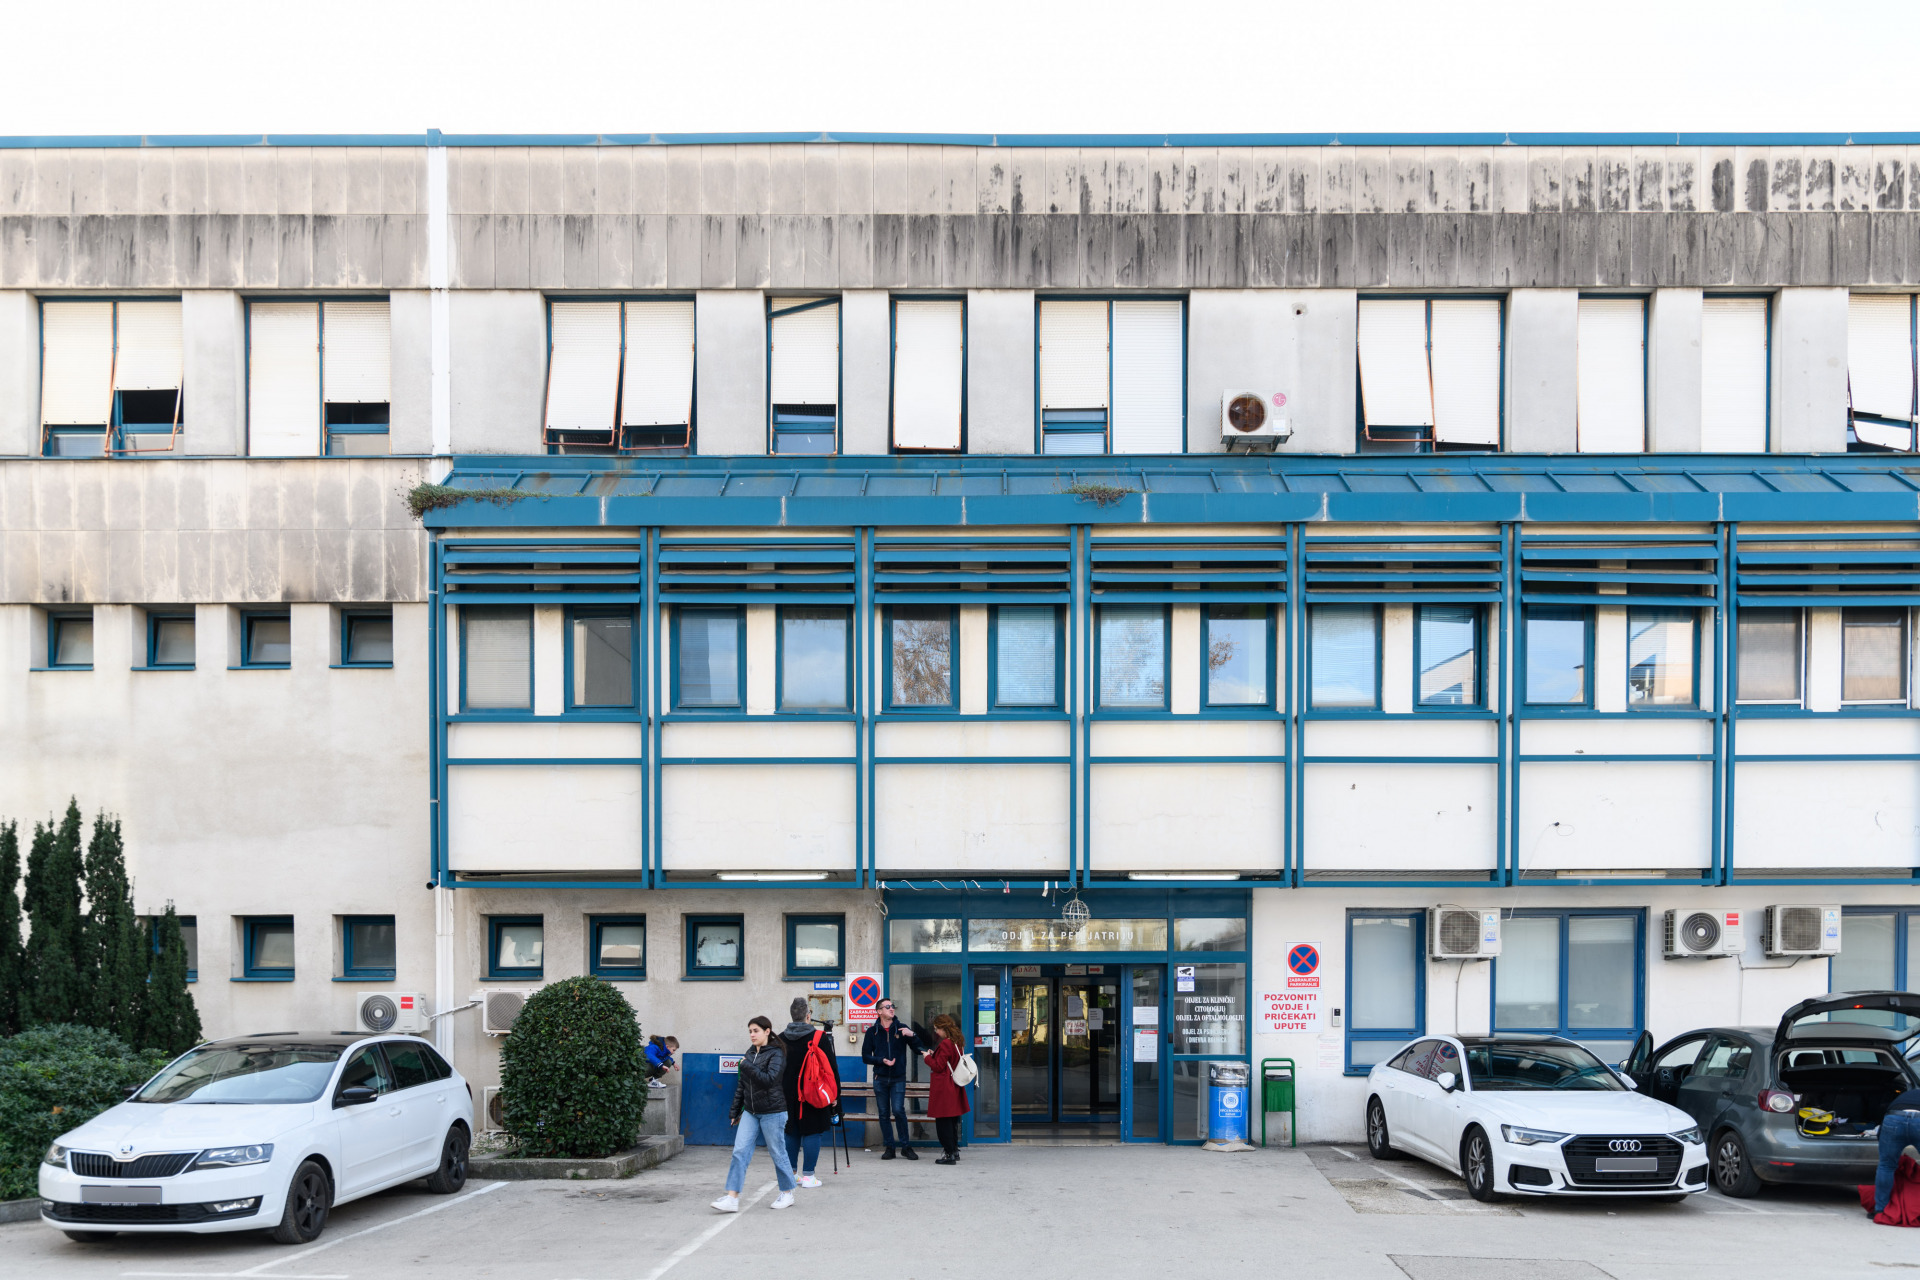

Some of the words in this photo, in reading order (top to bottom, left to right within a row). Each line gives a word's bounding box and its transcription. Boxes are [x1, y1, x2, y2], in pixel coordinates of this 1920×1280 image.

[1001, 931, 1036, 940] ODJL
[1041, 931, 1055, 940] ZA
[1060, 931, 1134, 940] PEDJATRIJU
[1210, 996, 1236, 1004] KLINIČKU
[1194, 1005, 1226, 1013] CITOLOGIJU
[1271, 1003, 1303, 1011] OVDJE
[1306, 1003, 1310, 1011] I
[1264, 1012, 1316, 1021] PRIČEKATI
[1273, 1022, 1307, 1030] UPUTE
